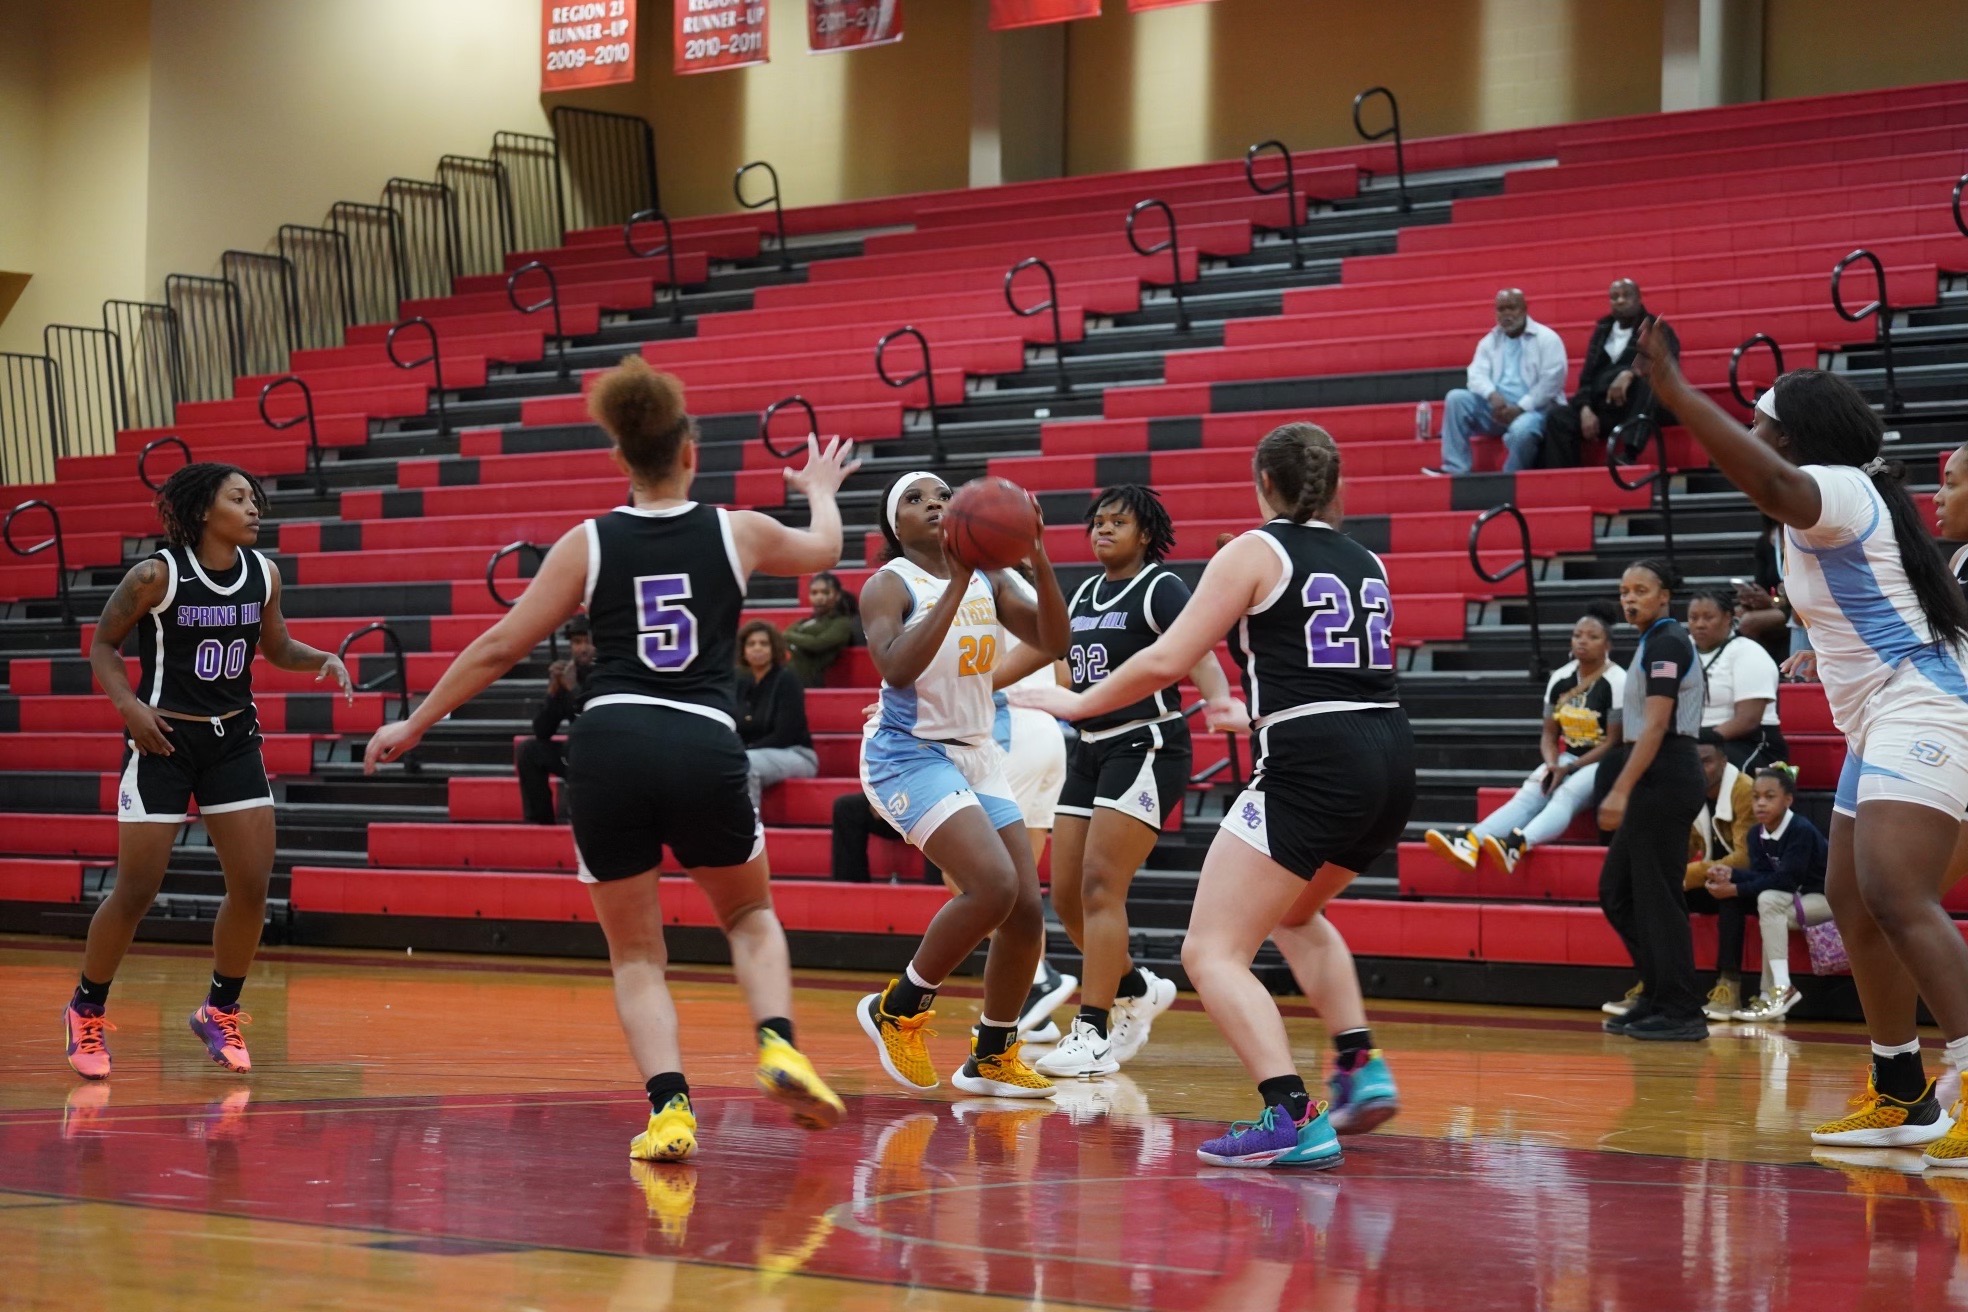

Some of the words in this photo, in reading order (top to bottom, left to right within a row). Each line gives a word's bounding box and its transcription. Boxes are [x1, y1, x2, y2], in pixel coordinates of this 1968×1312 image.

[552, 2, 606, 24] REGION
[683, 6, 766, 34] RUNNER-UP
[548, 19, 629, 45] RUNNER-UP
[684, 31, 763, 60] 2010-2011
[546, 42, 630, 71] 2009-2010
[177, 605, 237, 627] SPRING
[241, 601, 261, 625] HILL
[633, 573, 699, 672] 5
[1301, 572, 1394, 669] 22
[194, 638, 247, 681] 00
[958, 634, 996, 677] 20
[1070, 643, 1111, 684] 32
